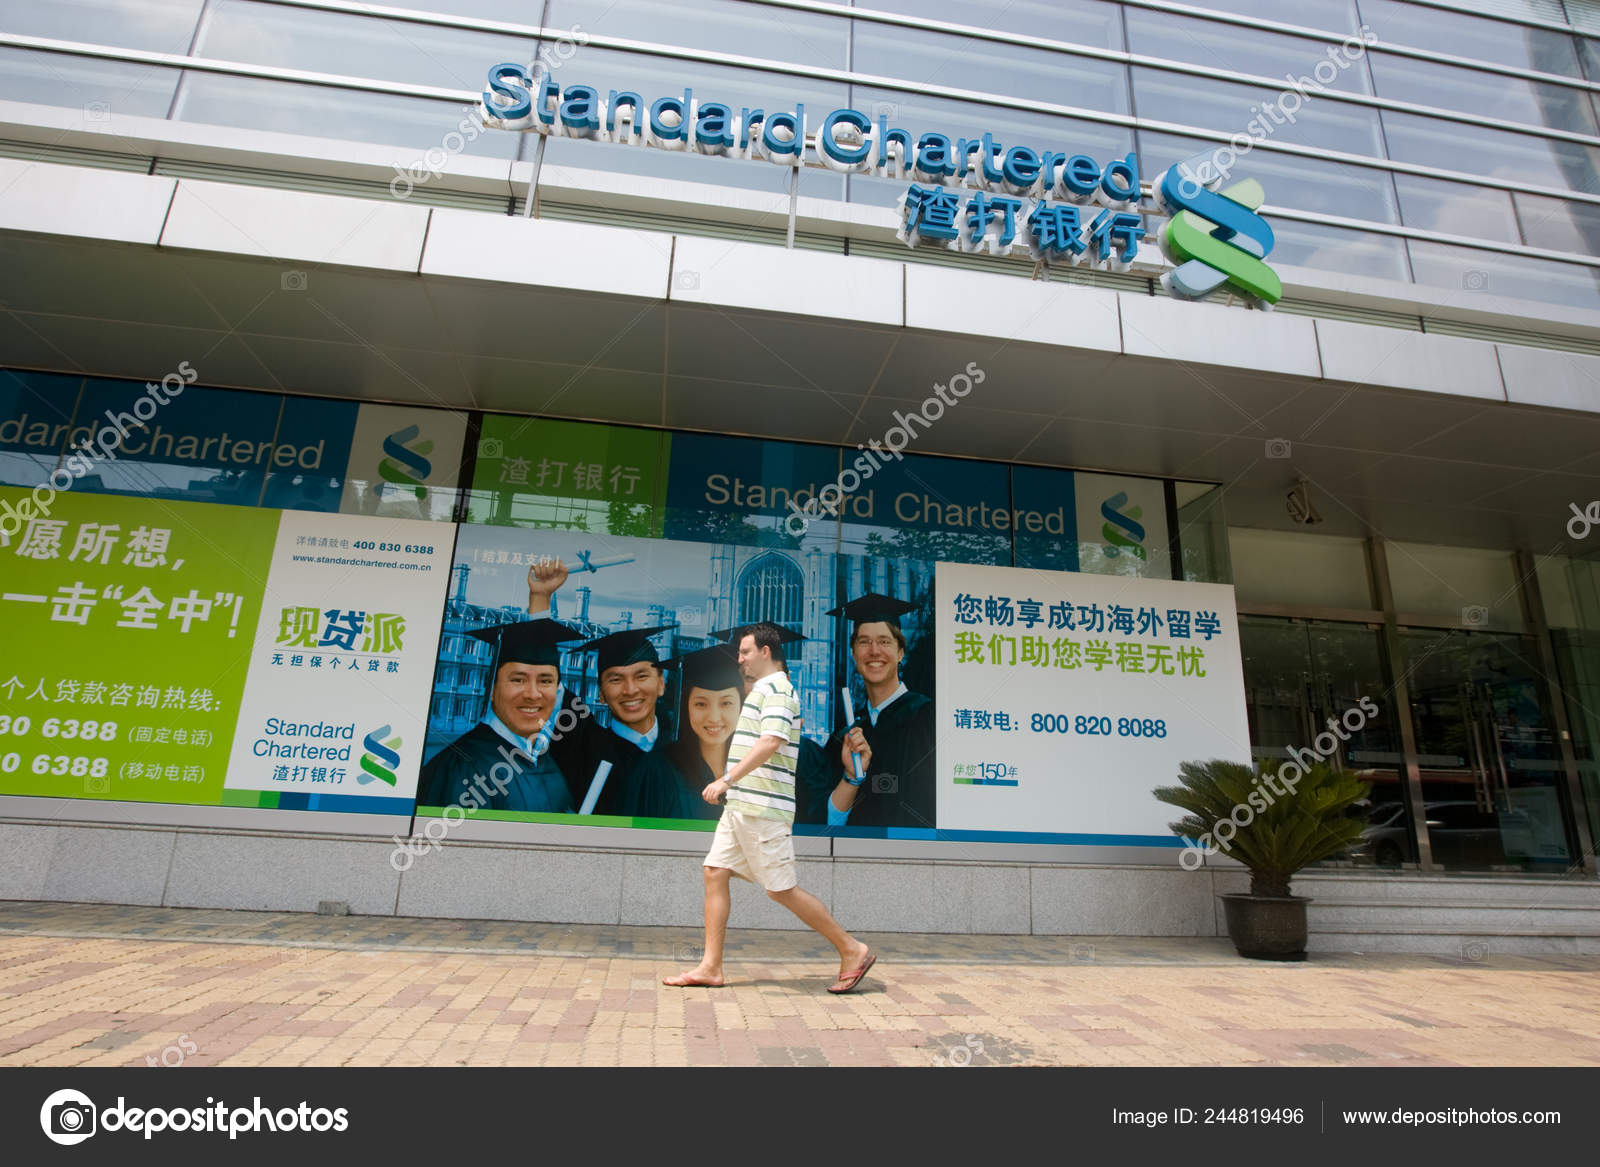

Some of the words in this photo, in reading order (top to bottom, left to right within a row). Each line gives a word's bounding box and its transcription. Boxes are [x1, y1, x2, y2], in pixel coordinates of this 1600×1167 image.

[482, 62, 805, 158] Standard
[821, 108, 1141, 203] Chartered
[900, 183, 1146, 265] 渣打银行
[119, 423, 325, 470] Chartered
[499, 455, 642, 495] 渣打银行
[894, 492, 1065, 535] Chartered
[0, 518, 185, 571] 愿所想，
[353, 540, 376, 551] 400
[379, 542, 401, 553] 830
[404, 544, 434, 555] 6388
[292, 554, 432, 571] www.standardchartered.com.cn
[275, 606, 407, 653] 现贷派
[953, 593, 1222, 641] 您畅享成功海外留学
[271, 652, 400, 674] 无担保个人贷款
[953, 631, 1207, 678] 我们助您学程无忧
[41, 718, 118, 742] 6388
[264, 718, 354, 740] Standard
[1030, 713, 1069, 734] 800
[1074, 716, 1112, 736] 820
[1117, 719, 1168, 738] 8088
[31, 754, 109, 778] 6388
[252, 739, 351, 762] Chartered
[272, 765, 346, 784] 渣打银行
